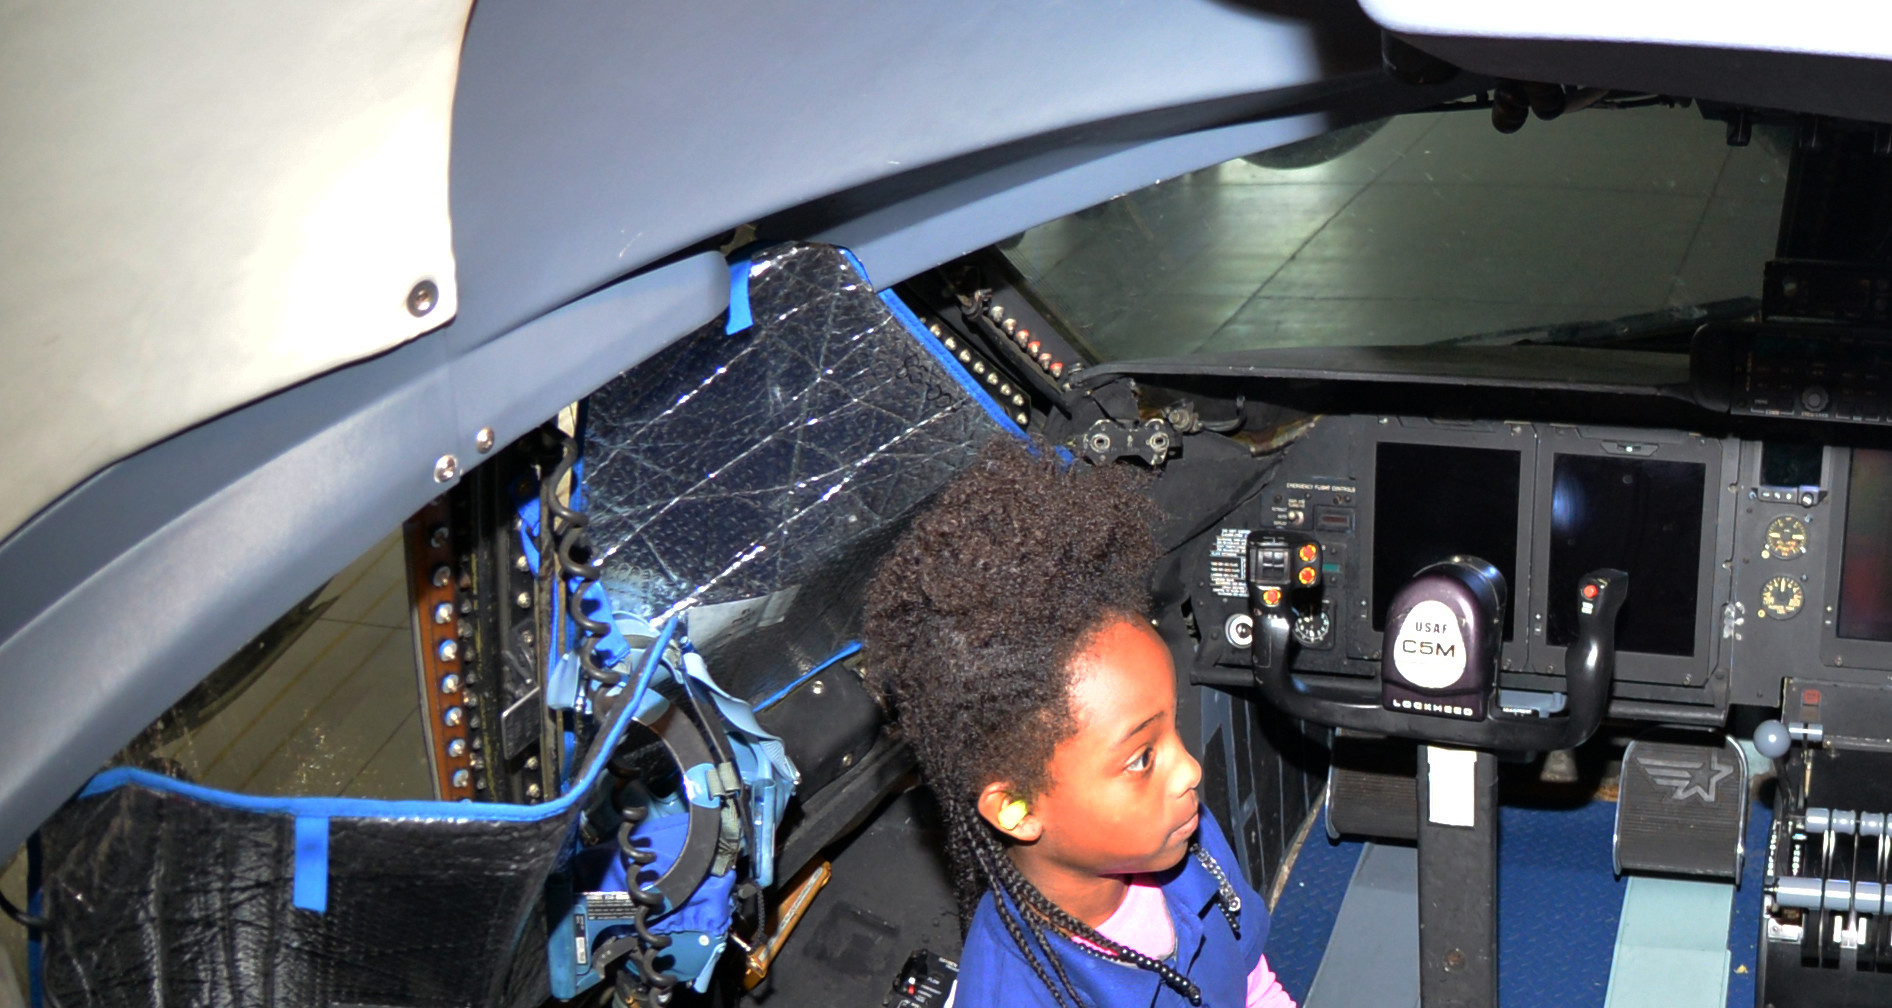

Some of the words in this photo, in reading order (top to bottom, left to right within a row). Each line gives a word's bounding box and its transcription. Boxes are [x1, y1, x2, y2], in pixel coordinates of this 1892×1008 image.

[1415, 621, 1448, 634] USAF
[1402, 639, 1455, 658] C5M
[1392, 699, 1473, 717] LOCKHEED
